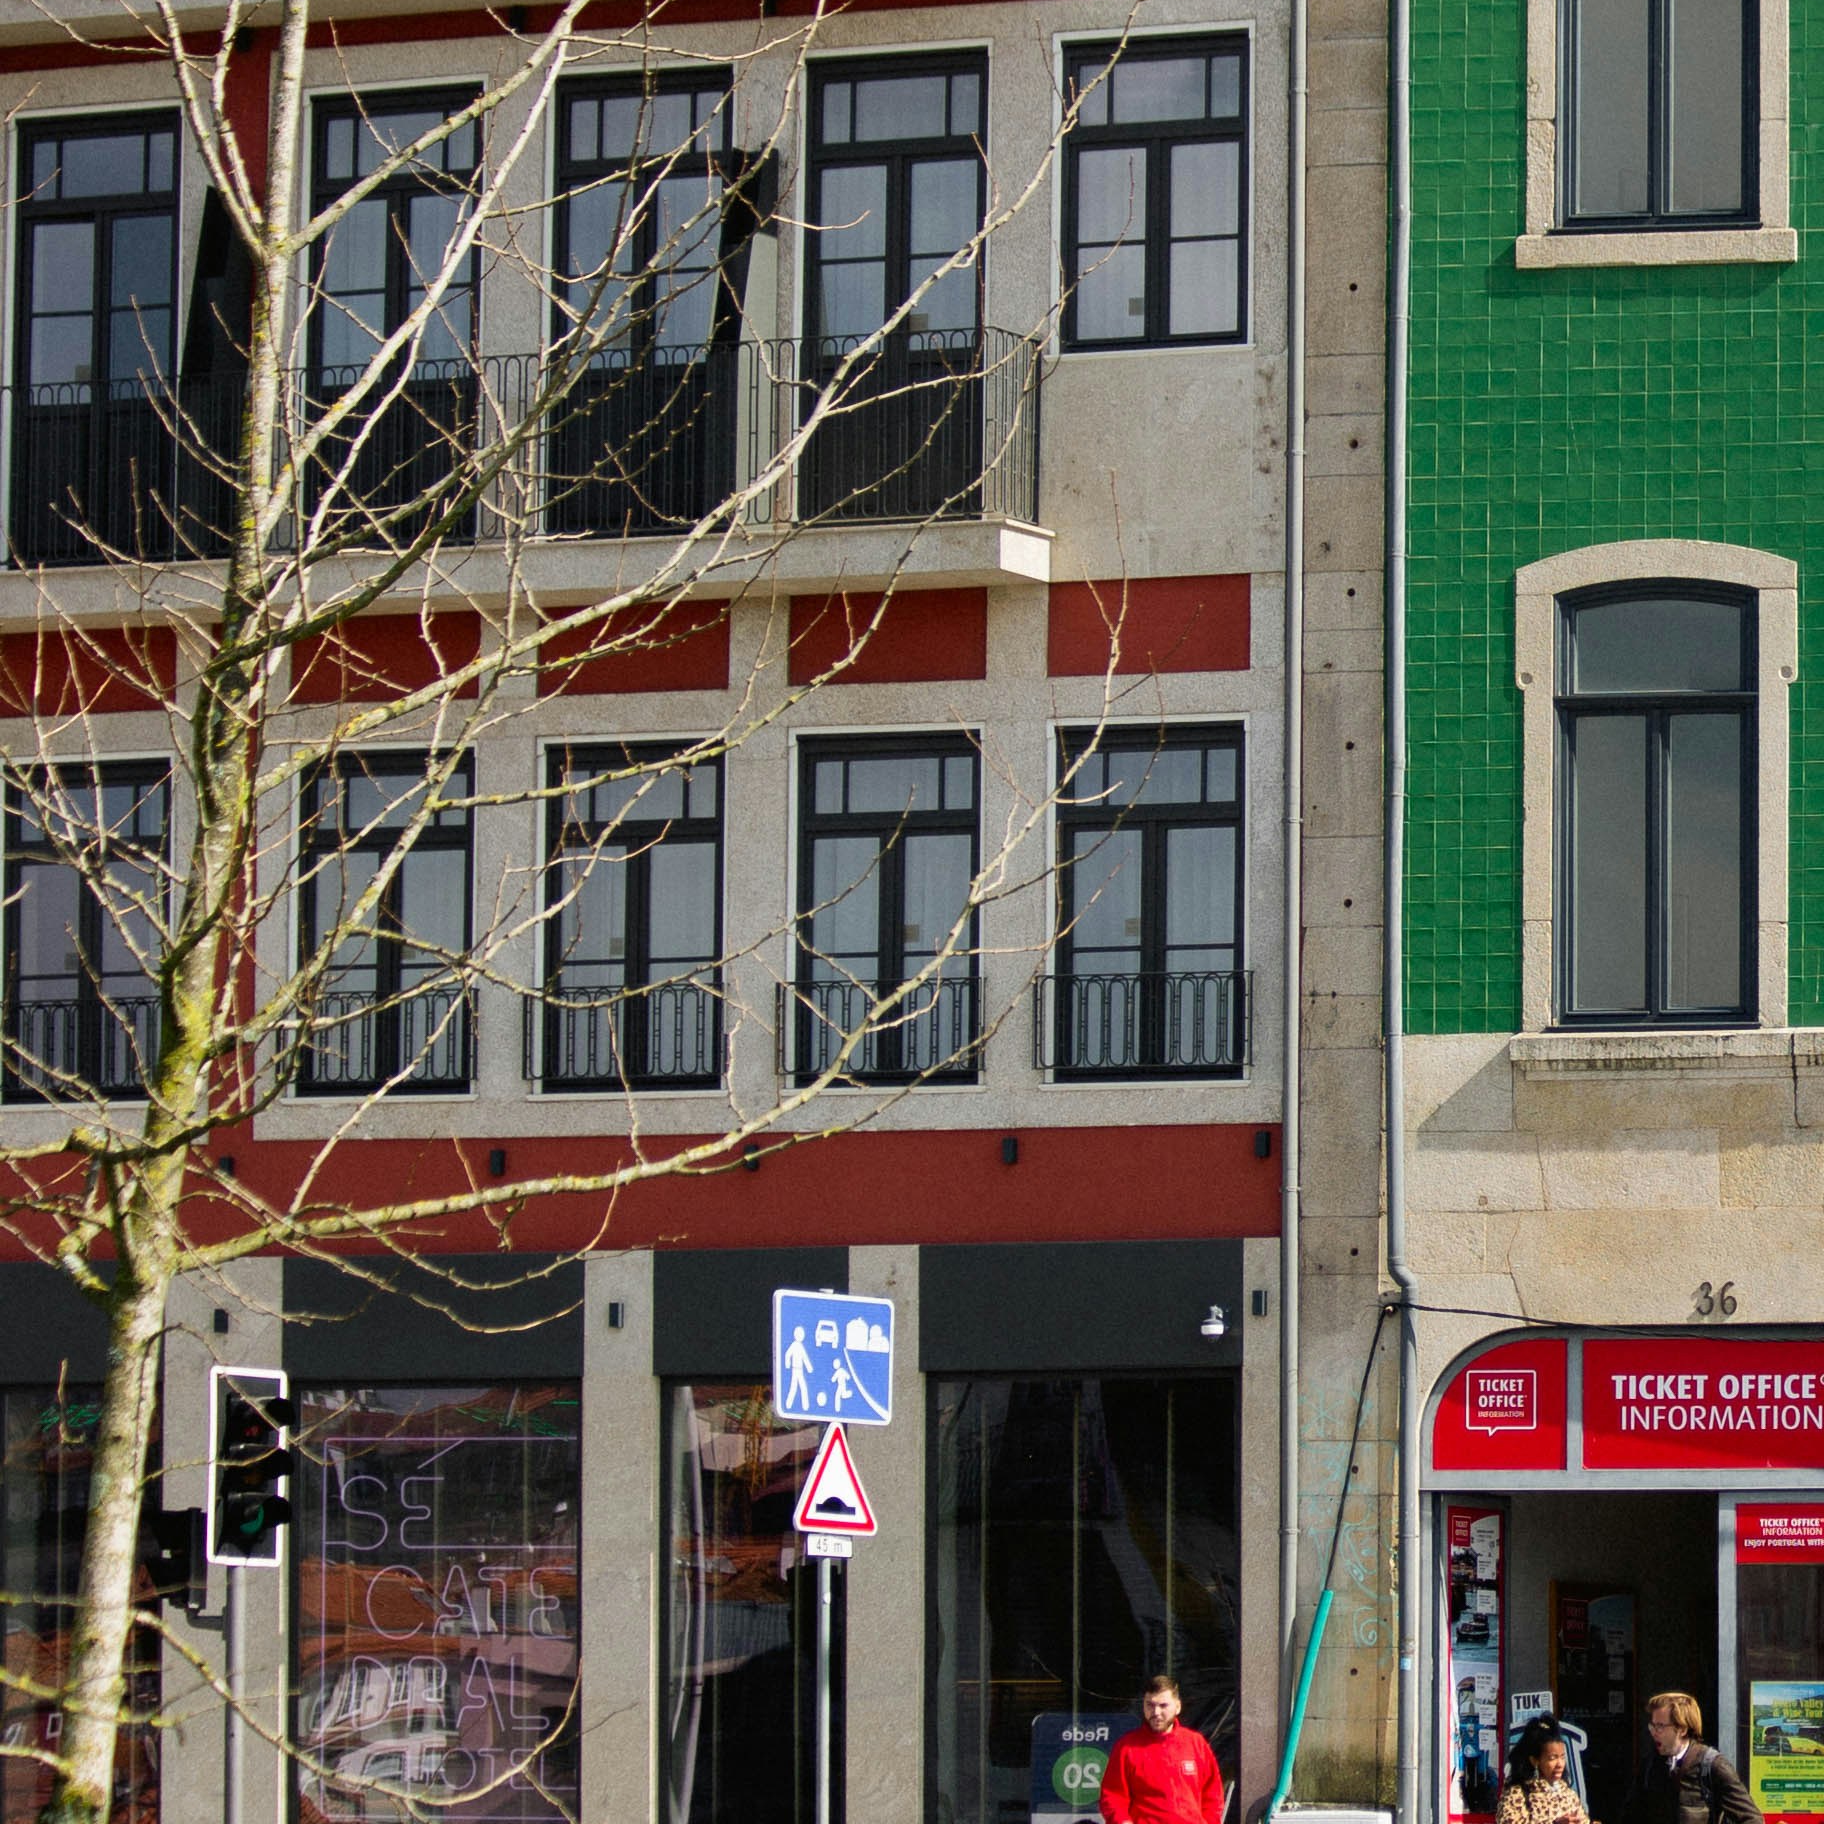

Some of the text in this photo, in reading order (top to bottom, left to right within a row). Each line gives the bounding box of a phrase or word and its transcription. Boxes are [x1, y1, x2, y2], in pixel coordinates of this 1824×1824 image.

[1696, 1281, 1738, 1315] 36
[1478, 1379, 1524, 1392] TICKET
[1611, 1374, 1708, 1400] TICKET
[1621, 1405, 1824, 1430] INFORMATION
[341, 1438, 464, 1551] SÉ
[1759, 1518, 1789, 1527] TICKET
[1762, 1527, 1823, 1536] INFORMATION
[834, 1542, 843, 1553] m
[1744, 1539, 1765, 1548] ENJOY
[1767, 1539, 1805, 1547] PORTUGAL
[367, 1564, 574, 1641] CATE
[352, 1655, 550, 1732] DRAL
[1514, 1694, 1541, 1710] TUK
